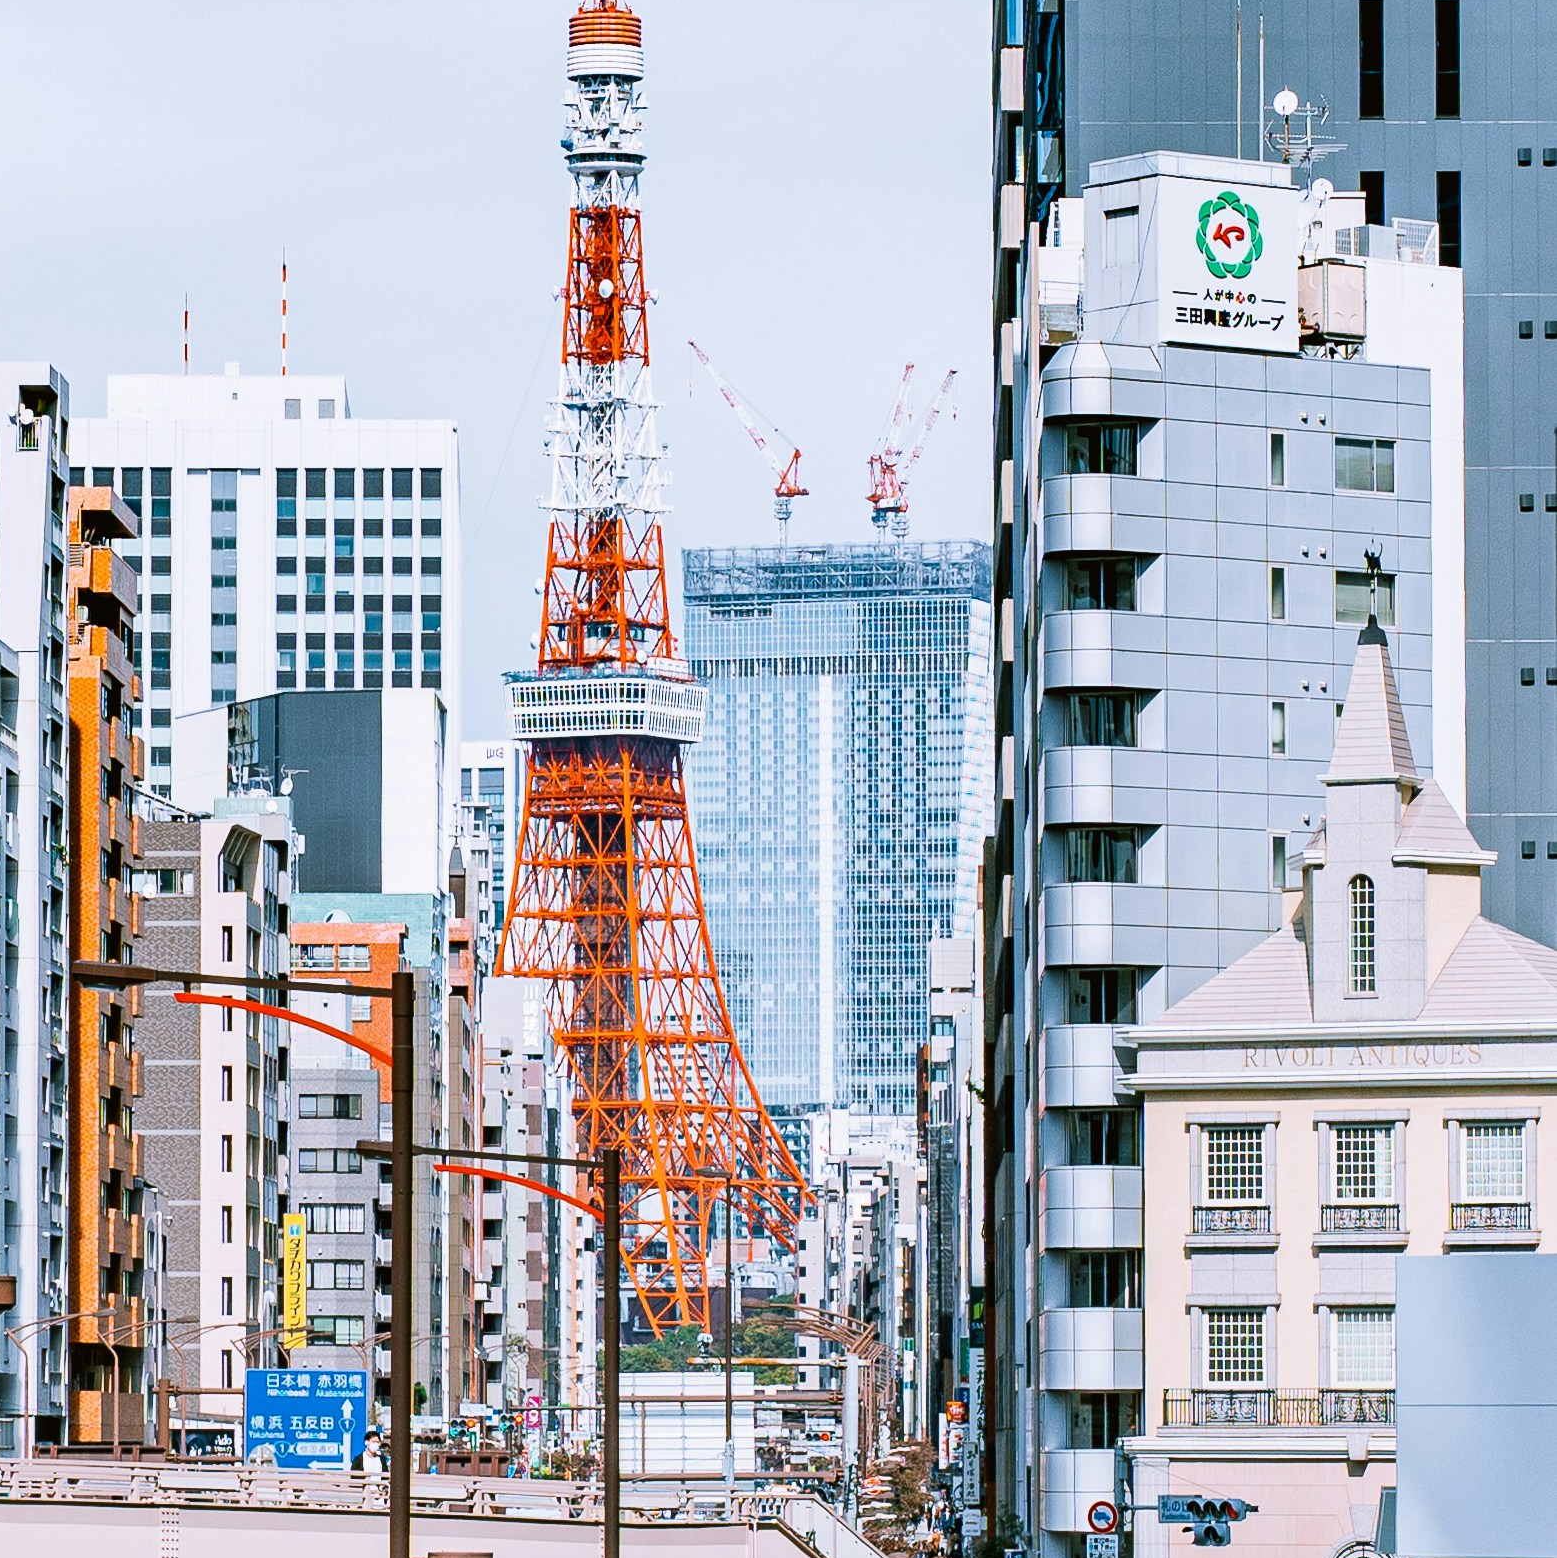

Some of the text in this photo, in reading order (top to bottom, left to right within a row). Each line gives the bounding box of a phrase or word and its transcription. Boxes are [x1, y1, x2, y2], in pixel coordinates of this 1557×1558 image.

[1203, 288, 1257, 304] 人が中心の
[1244, 1044, 1482, 1068] RIVOLI ANTIQUES
[267, 1373, 310, 1388] 日本橋
[317, 1374, 362, 1389] 赤羽橋
[251, 1415, 283, 1430] 横浜
[289, 1416, 334, 1430] 五反田
